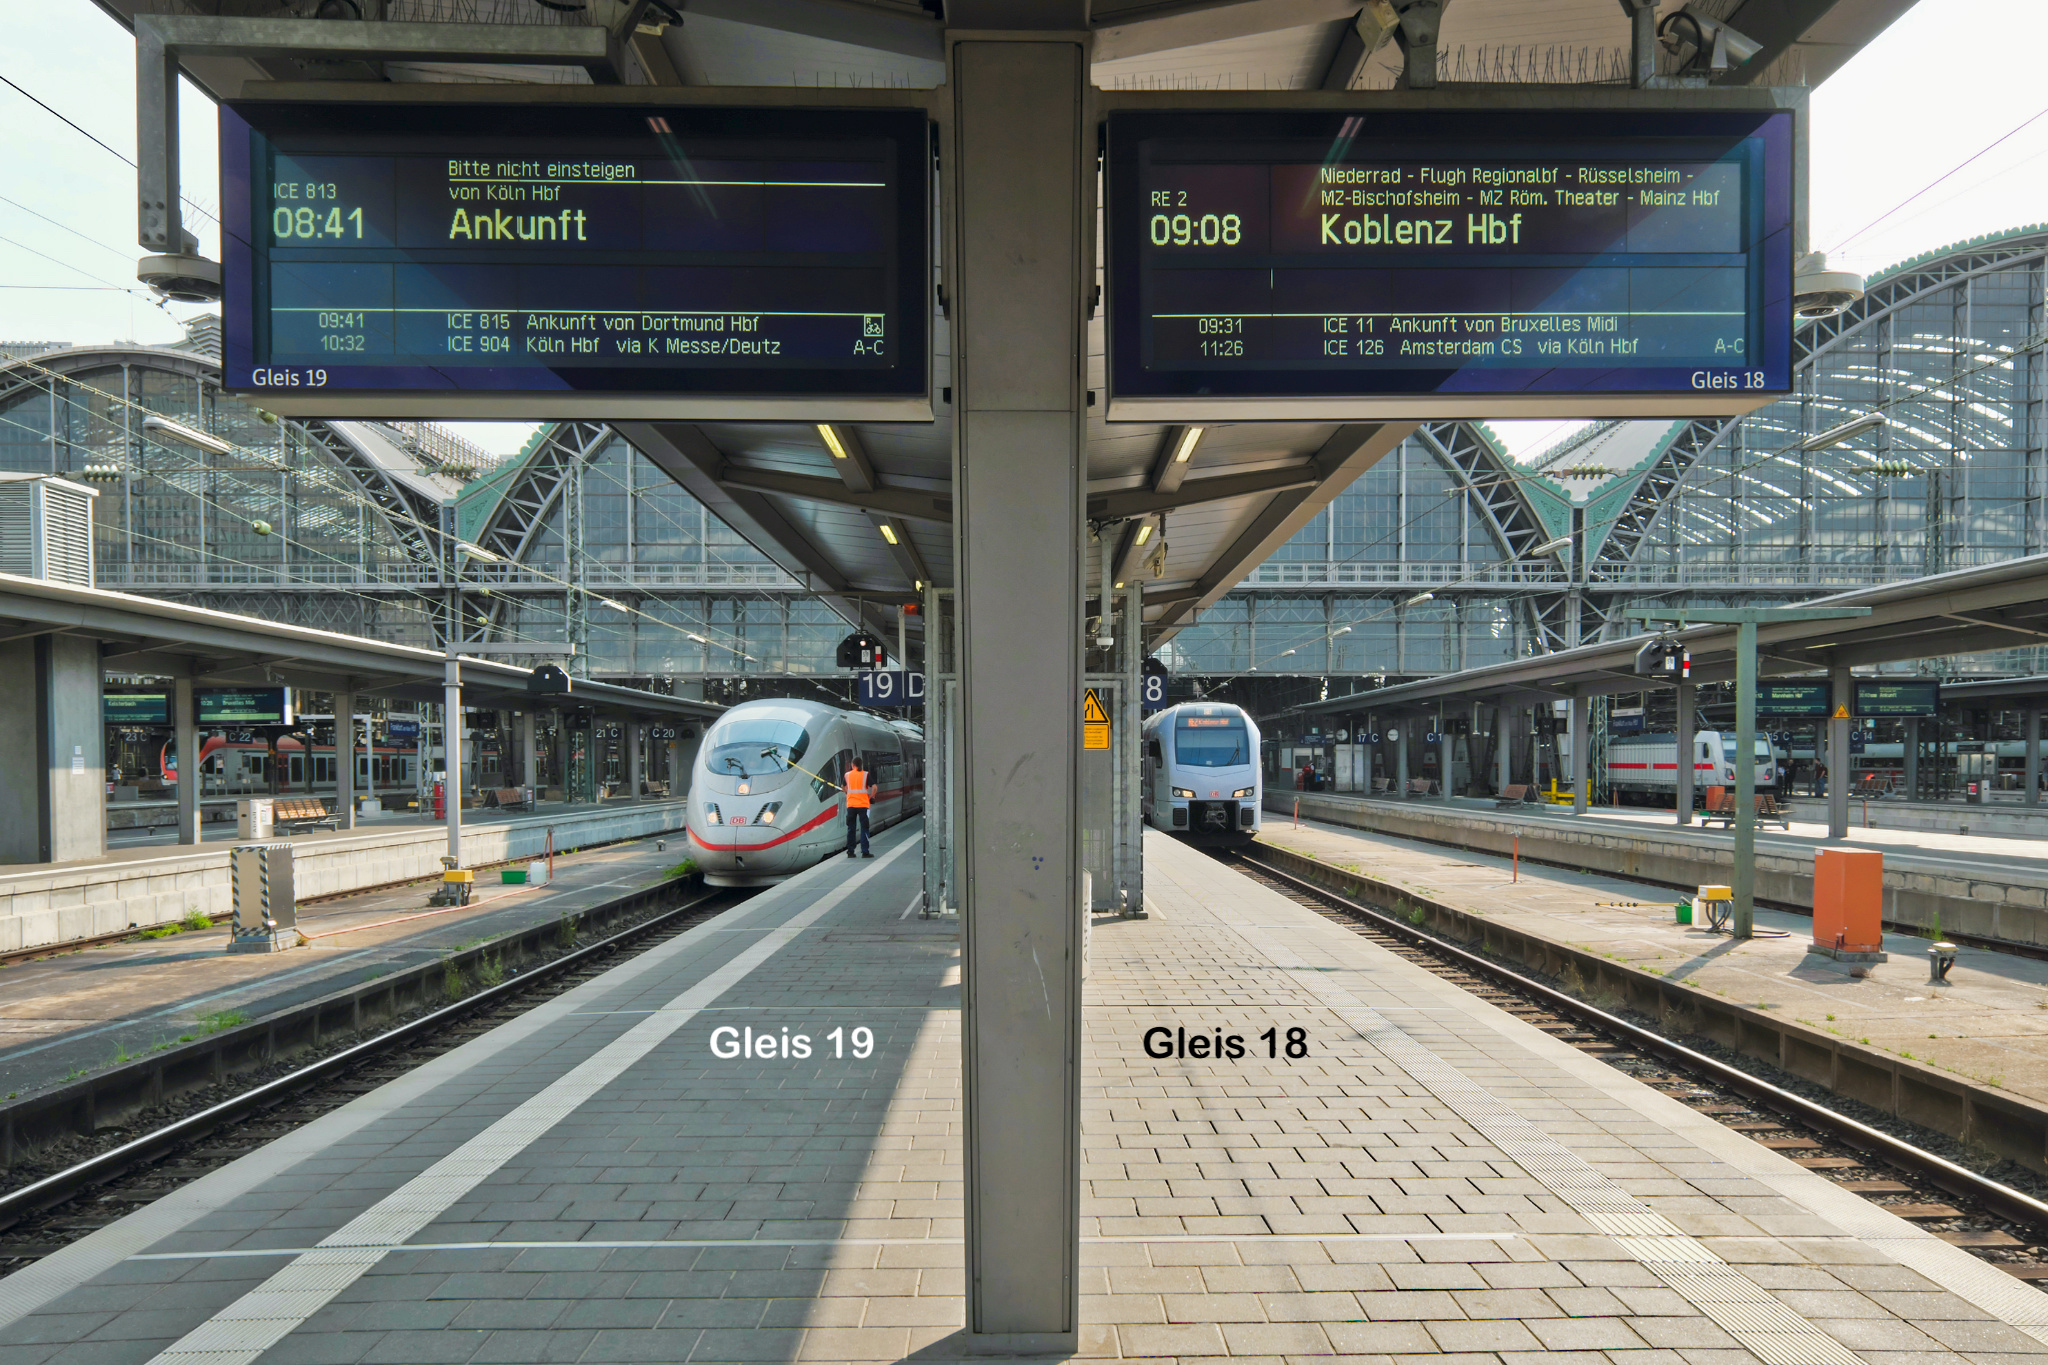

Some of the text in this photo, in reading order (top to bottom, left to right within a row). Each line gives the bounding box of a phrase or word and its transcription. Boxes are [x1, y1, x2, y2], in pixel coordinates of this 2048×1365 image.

[449, 160, 635, 180] Bitte nicht einsteigen
[1321, 168, 1401, 184] Niederrad
[1421, 168, 1466, 186] Flugh
[1473, 168, 1559, 186] Regionalbf
[1579, 168, 1681, 184] Rüsselsheim
[273, 183, 337, 199] ICE 813
[449, 185, 561, 201] von Köln Hbf
[1152, 190, 1187, 206] RE 2
[1321, 189, 1460, 207] MZ-Bischofsheim
[1480, 190, 1503, 206] MZ
[1510, 189, 1548, 206] Röm.
[1555, 189, 1620, 206] Theater
[1641, 189, 1686, 206] Mainz
[1693, 189, 1720, 206] Hbf
[273, 207, 363, 239] 08:41
[449, 208, 587, 241] Ankunft
[1150, 214, 1241, 246] 09:08
[1321, 213, 1523, 245] Koblenz Hbf
[318, 314, 364, 329] 09:41
[447, 315, 760, 333] ICE 815 Ankunft von Dortmund Hbf
[1198, 317, 1243, 334] 09:31
[1323, 317, 1618, 333] ICE 11 Ankunft von Bruxelles Midi
[320, 335, 365, 351] 10:32
[447, 336, 781, 355] ICE 904 Köln Hbf via K Messe/Deutz
[853, 340, 884, 356] A-C
[1200, 340, 1244, 357] 11:26
[1323, 338, 1639, 356] ICE 126 Amsterdam CS via Köln Hbf
[1714, 337, 1745, 354] A-C
[252, 368, 328, 387] Gleis 19
[1691, 371, 1766, 389] Gleis 18
[862, 672, 925, 699] 19 D
[125, 732, 147, 742] 23 C
[229, 732, 251, 742] C 22
[596, 728, 618, 738] 21 C
[652, 728, 675, 738] C 20
[1357, 733, 1379, 743] 17 C
[1426, 732, 1434, 742] C
[1783, 731, 1790, 741] C
[1851, 731, 1873, 741] C 14
